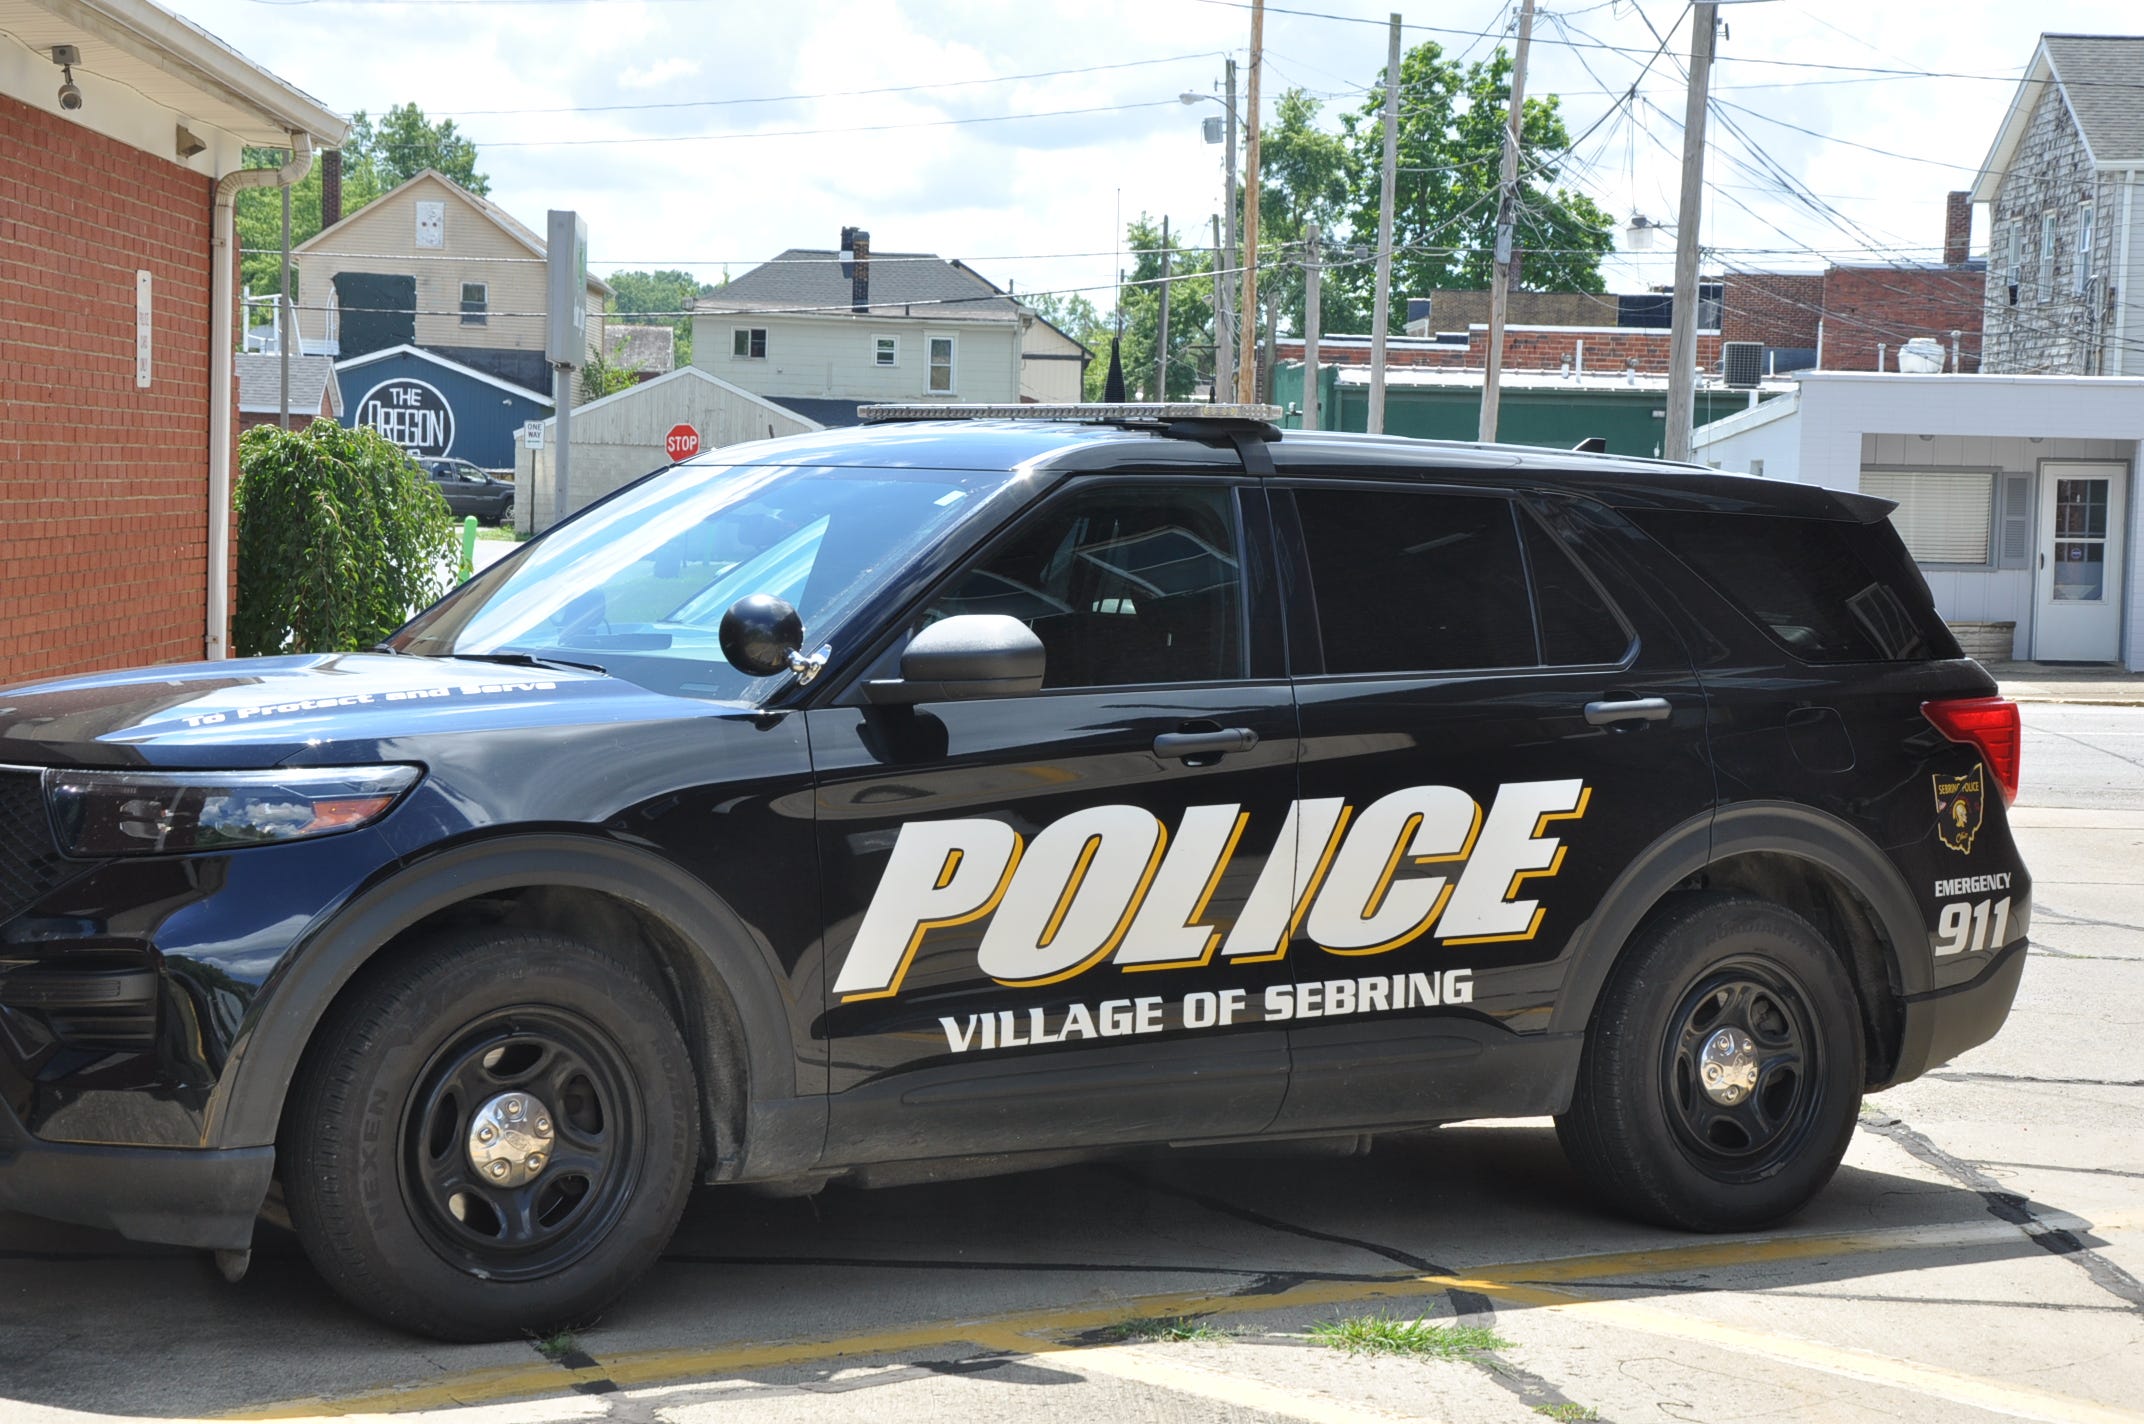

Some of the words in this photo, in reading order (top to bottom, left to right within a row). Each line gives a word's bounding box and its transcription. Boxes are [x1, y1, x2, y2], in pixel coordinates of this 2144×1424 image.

[389, 388, 422, 406] THE
[368, 400, 444, 447] OREGON
[527, 423, 543, 431] ONE
[528, 431, 542, 439] WAY
[667, 435, 698, 452] STOP
[182, 712, 226, 727] To
[236, 694, 375, 719] Protect
[385, 687, 450, 701] and
[459, 680, 557, 695] Serve
[832, 778, 1592, 1003] POLICE
[1934, 872, 2011, 897] EMERGENCY
[1934, 896, 2011, 957] 911
[938, 997, 1163, 1053] VILLAGE
[1183, 990, 1247, 1028] OF
[1264, 968, 1474, 1022] SEBRING
[360, 1087, 390, 1232] NEXEN
